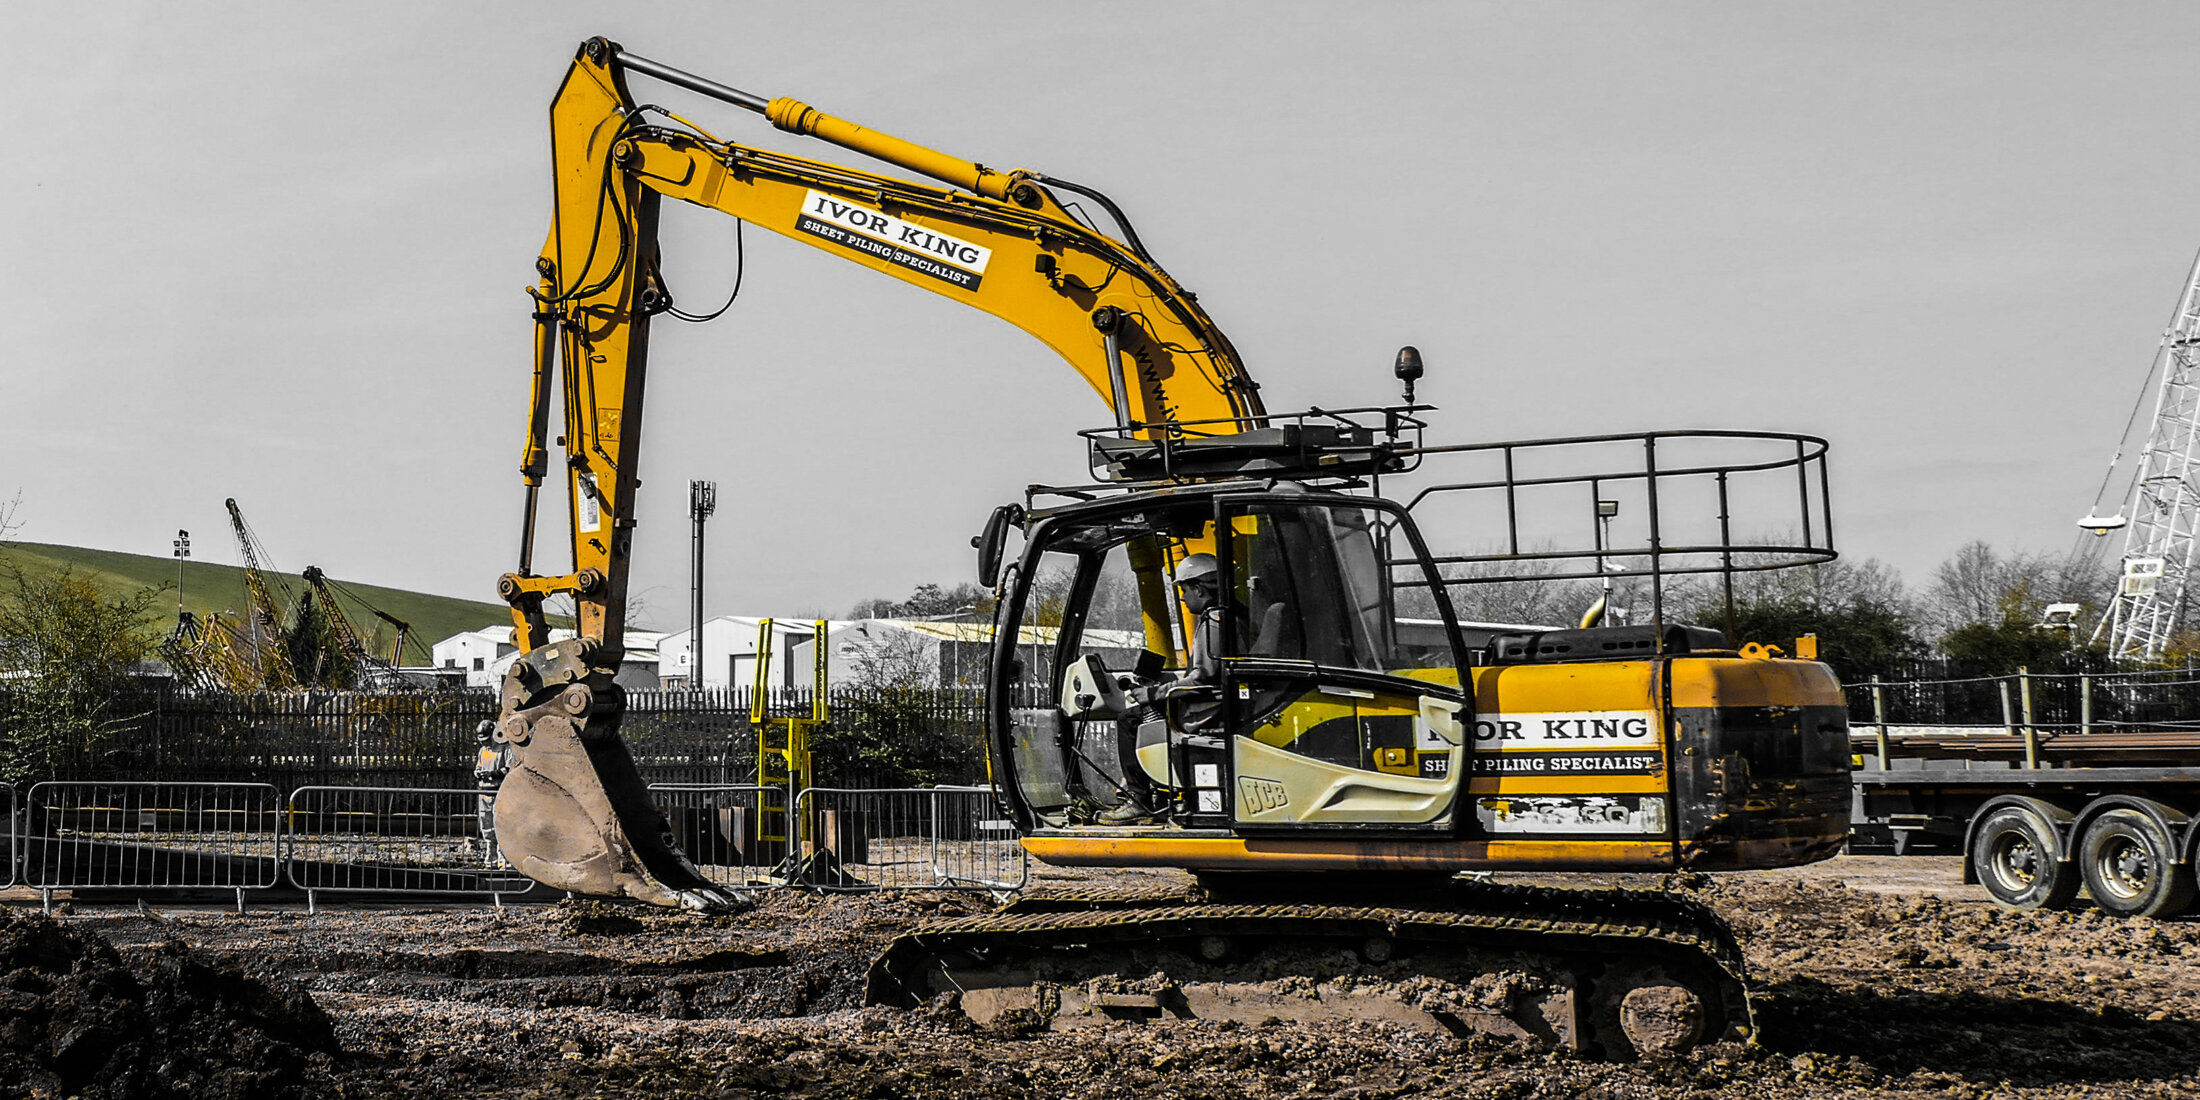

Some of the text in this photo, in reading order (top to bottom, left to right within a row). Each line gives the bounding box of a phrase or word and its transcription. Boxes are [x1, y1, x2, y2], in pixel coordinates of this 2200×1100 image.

[814, 197, 980, 264] IVOR KING
[803, 220, 970, 285] SHEET PILING SPECIALIST
[1542, 718, 1648, 739] KING
[1485, 758, 1545, 771] PILING
[1550, 757, 1654, 770] SPECIALIST
[1244, 779, 1289, 815] JCB
